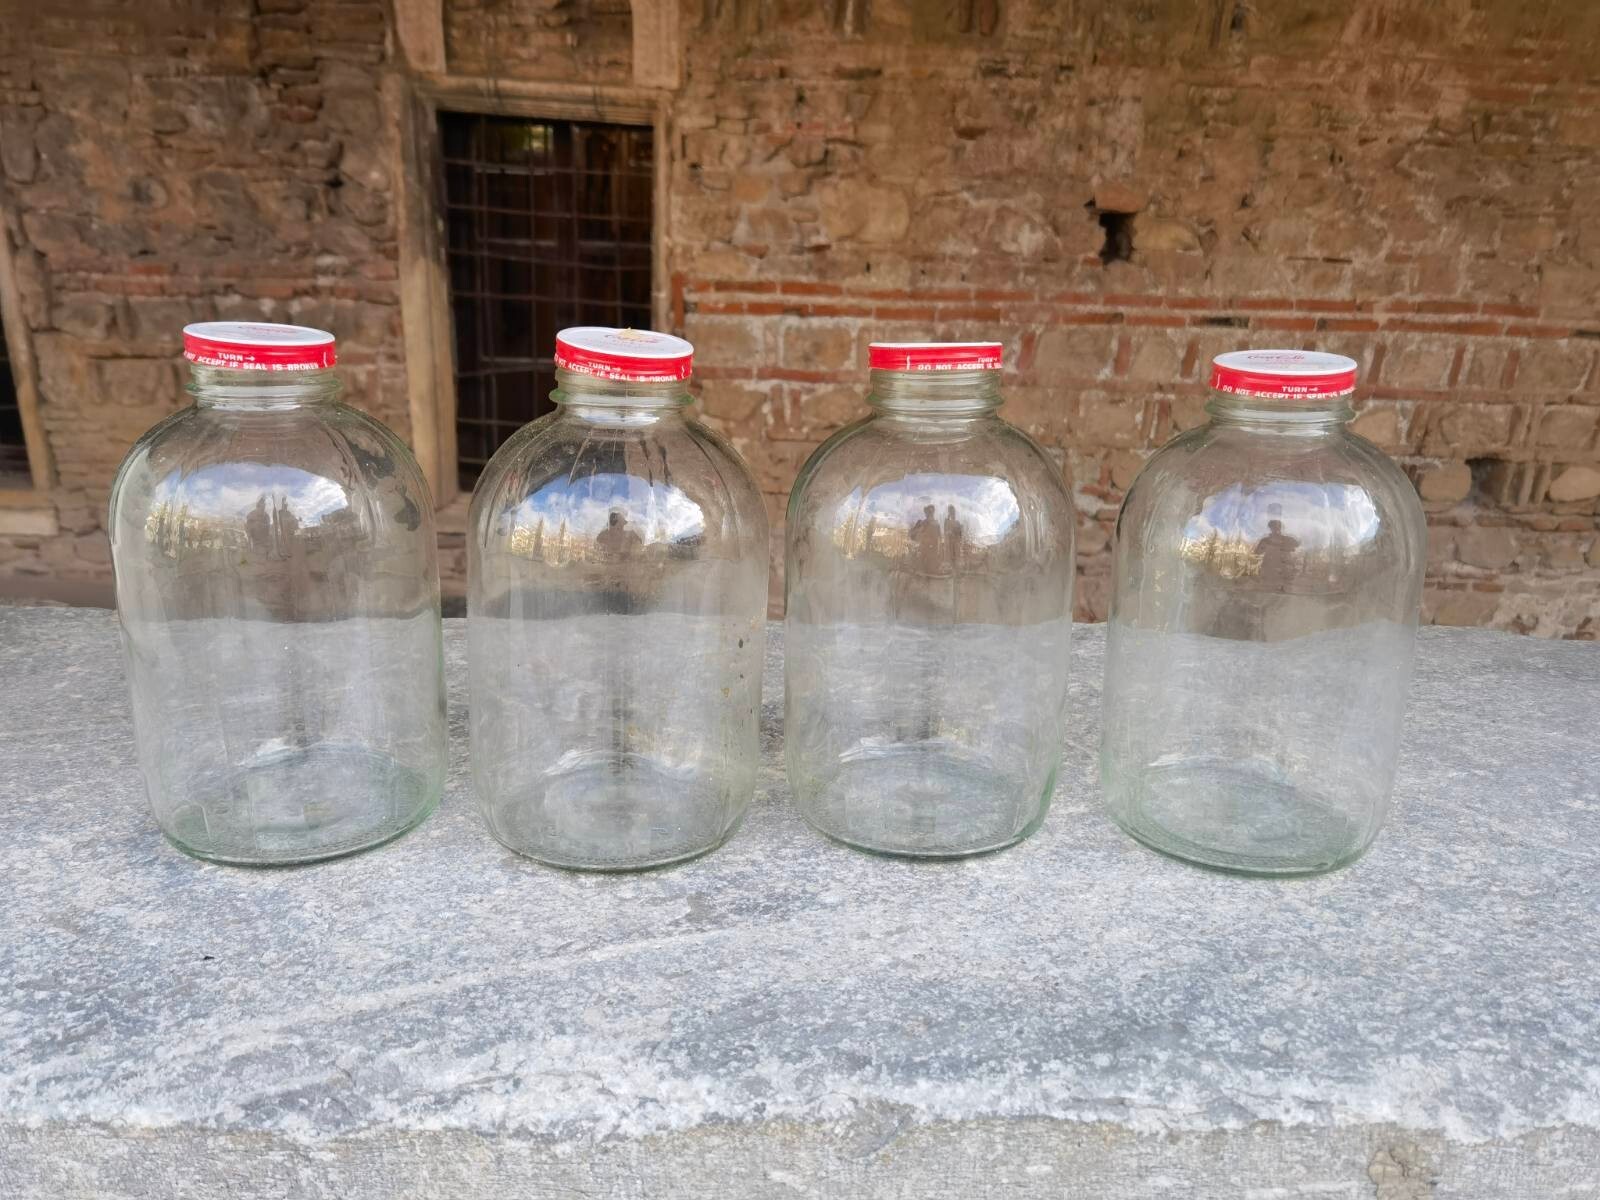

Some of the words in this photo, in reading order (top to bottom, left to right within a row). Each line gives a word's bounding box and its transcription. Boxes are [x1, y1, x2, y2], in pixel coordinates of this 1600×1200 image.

[197, 355, 225, 367] ACCEPT
[243, 362, 268, 370] SEAL
[272, 363, 282, 371] IS
[218, 352, 243, 361] TURN
[568, 362, 594, 376] ACCEPT
[596, 368, 606, 377] IF
[609, 372, 632, 381] SEAL
[587, 361, 611, 371] TURN
[1222, 385, 1233, 393] DO
[1234, 387, 1250, 396] NOT
[1255, 390, 1290, 399] ACCEPT
